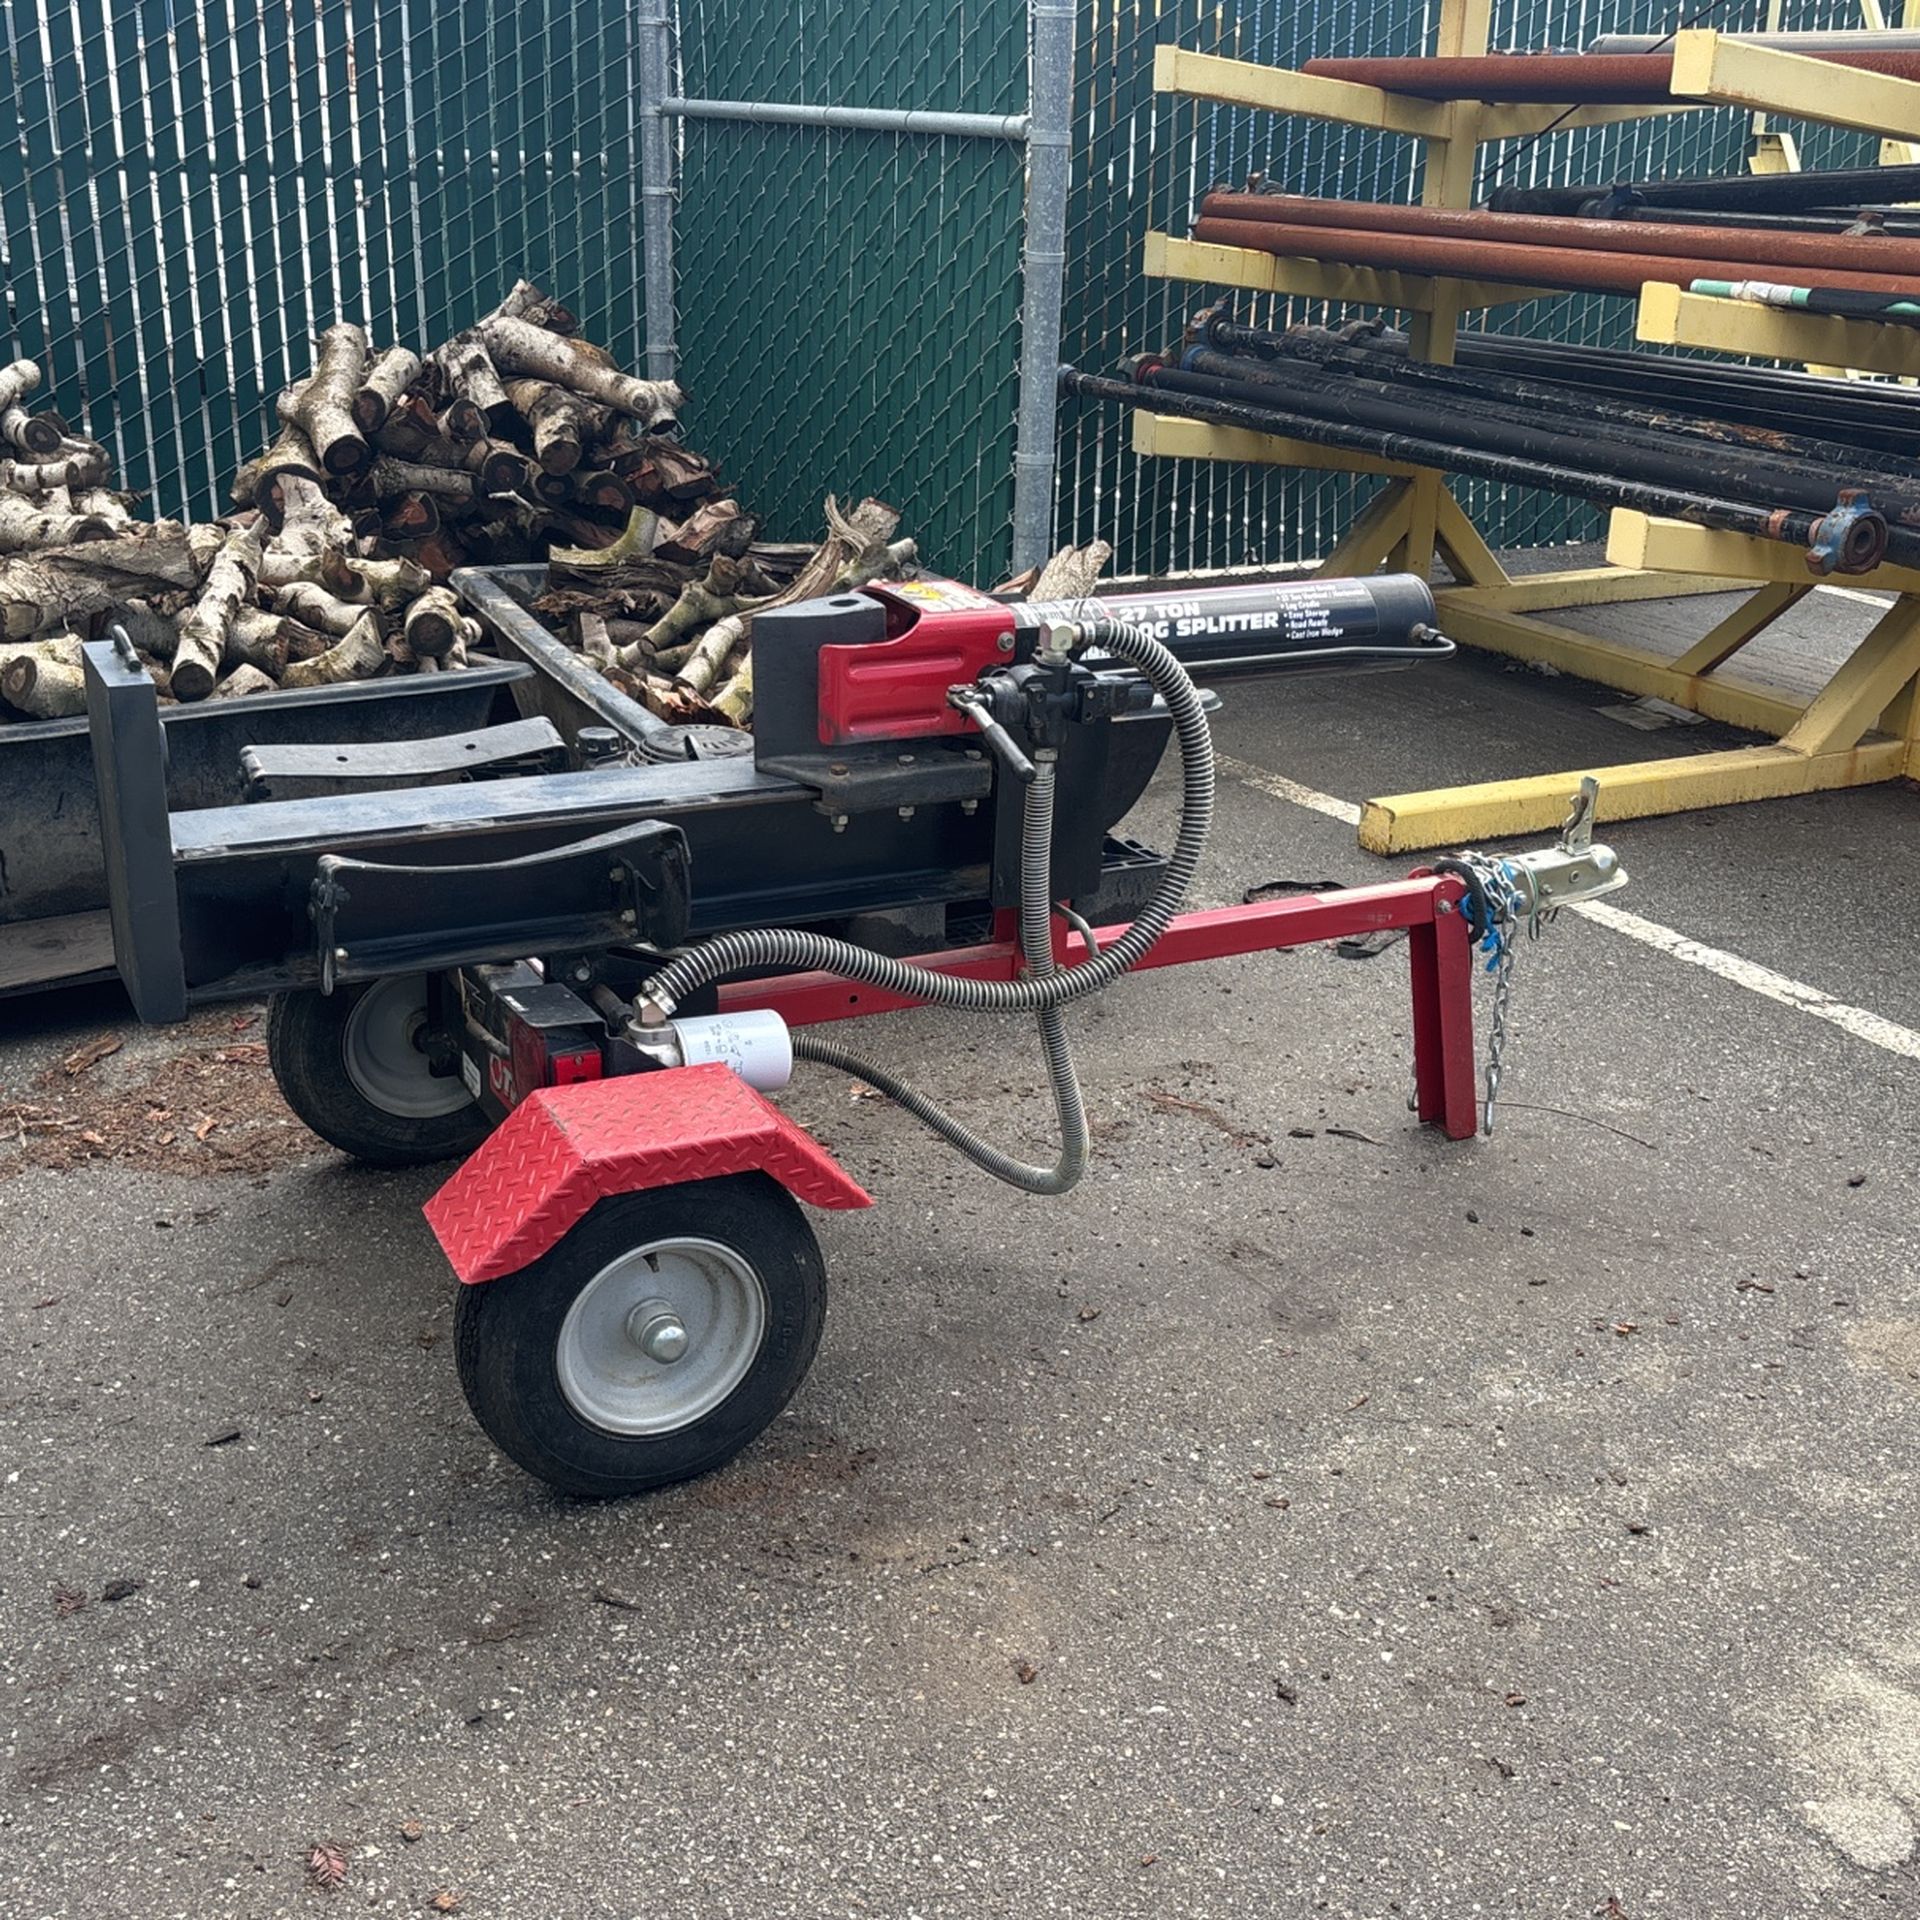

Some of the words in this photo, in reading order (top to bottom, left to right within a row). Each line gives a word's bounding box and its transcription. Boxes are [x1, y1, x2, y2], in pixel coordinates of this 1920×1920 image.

[1119, 606, 1147, 622] 27
[1154, 602, 1200, 619] TON
[1137, 620, 1169, 639] OG
[1176, 611, 1279, 637] SPLITTER
[1291, 630, 1305, 640] Cast
